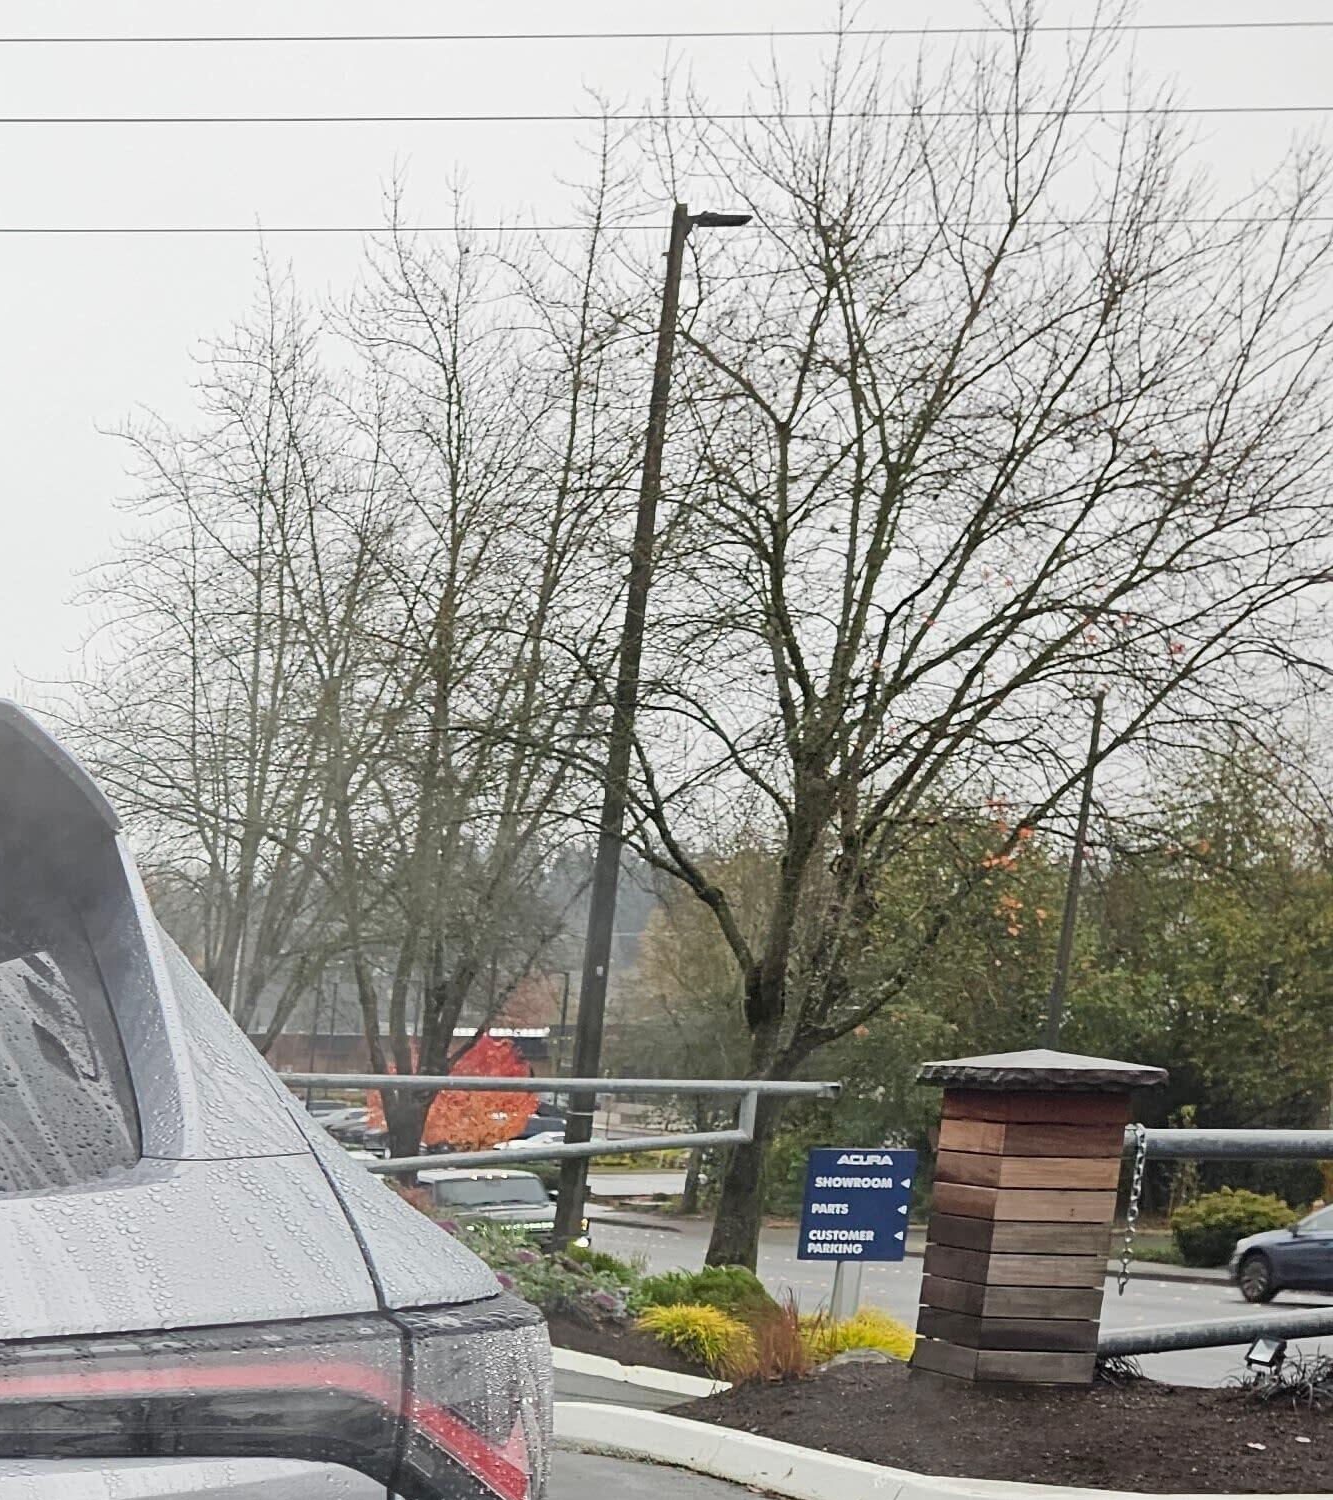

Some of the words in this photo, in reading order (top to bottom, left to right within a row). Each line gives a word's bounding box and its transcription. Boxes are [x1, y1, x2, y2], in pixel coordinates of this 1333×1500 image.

[837, 1154, 894, 1166] ACURA
[814, 1177, 893, 1189] SHOWROOM
[811, 1204, 849, 1215] PARTS
[808, 1230, 874, 1242] CUSTOMER
[807, 1243, 863, 1255] PARKING
